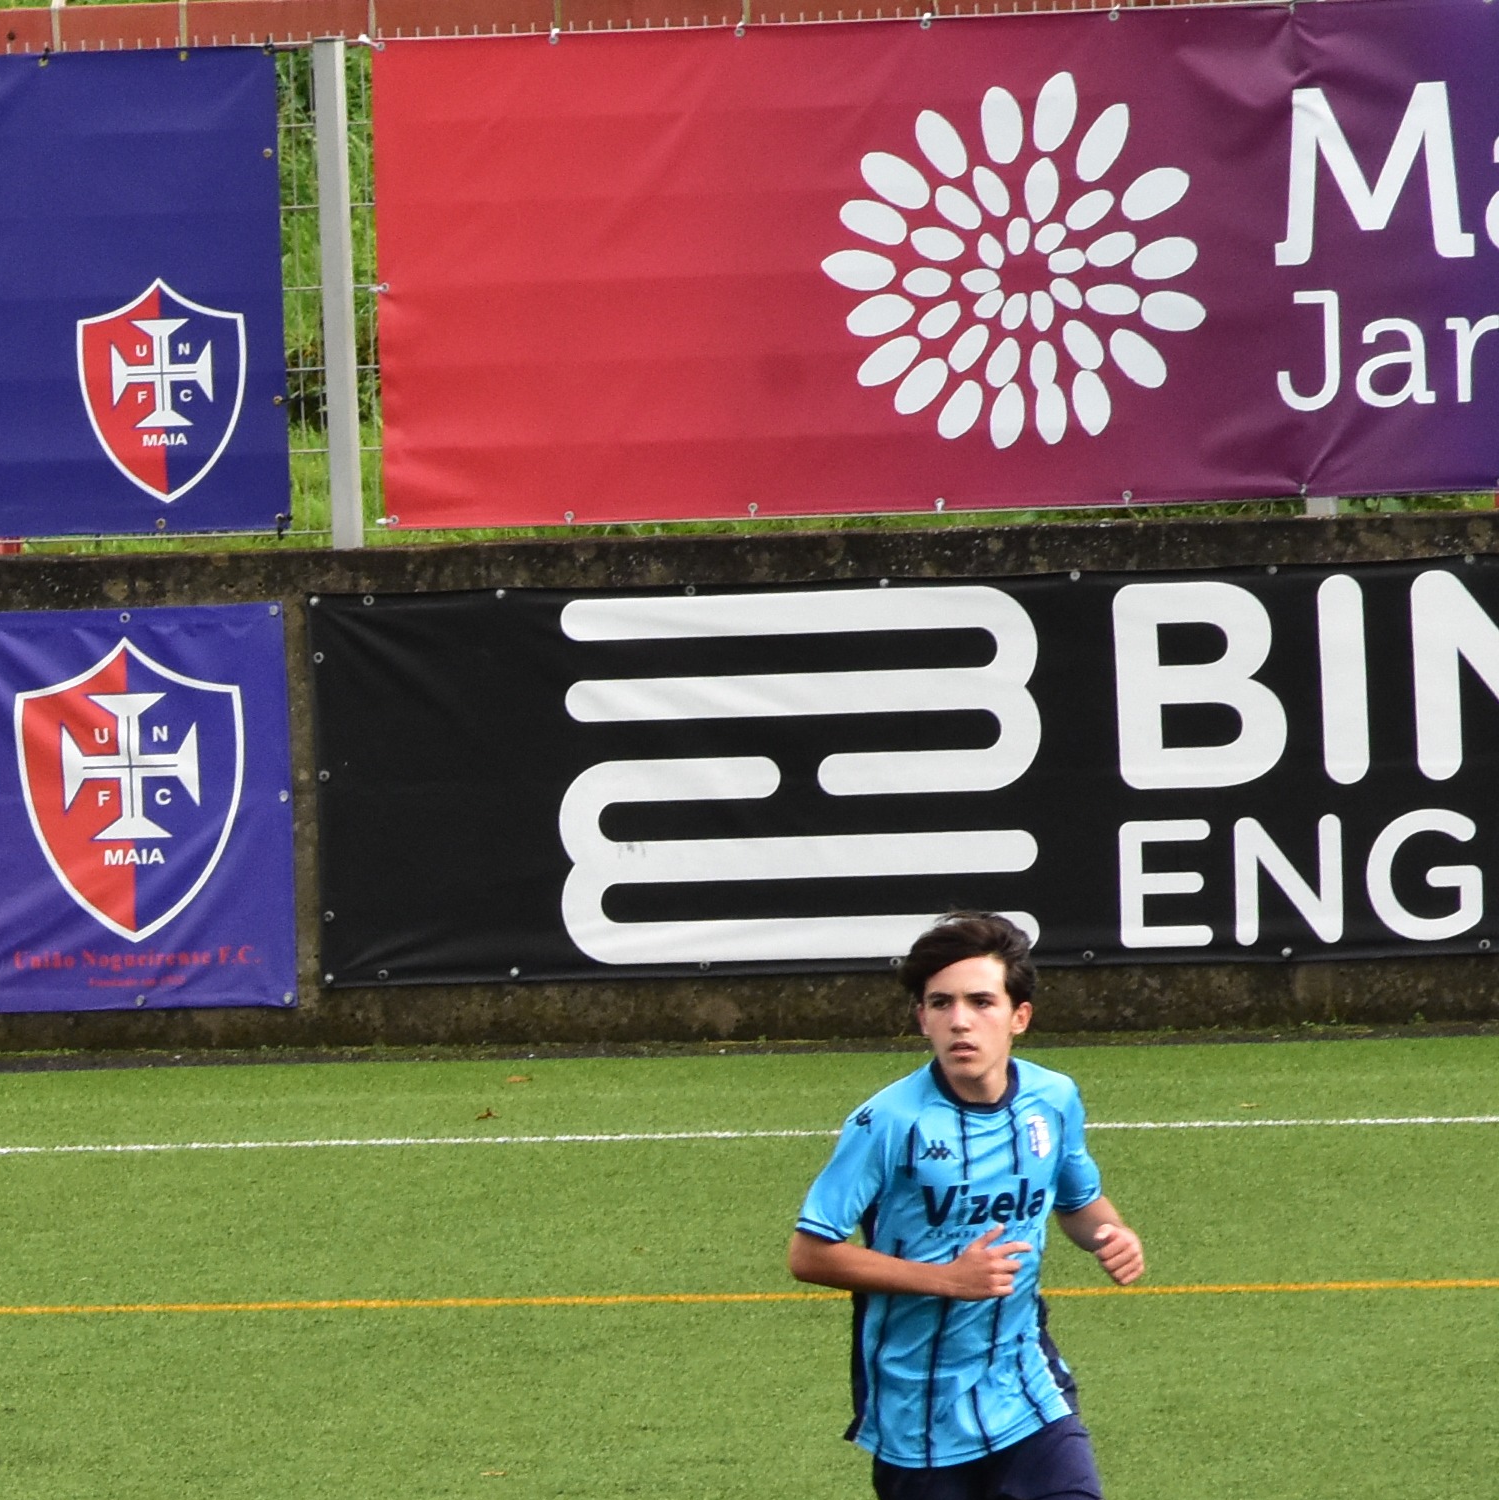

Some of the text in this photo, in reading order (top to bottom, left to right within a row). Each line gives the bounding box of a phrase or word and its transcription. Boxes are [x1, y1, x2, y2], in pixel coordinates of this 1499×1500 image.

[1275, 81, 1499, 266] M
[135, 342, 191, 358] U N
[1277, 290, 1499, 411] Jar
[137, 388, 193, 404] F C
[142, 433, 188, 446] MAIA
[94, 725, 169, 744] U N
[97, 788, 172, 807] F C
[104, 848, 166, 866] MAIA
[1118, 808, 1484, 948] ENG
[922, 1178, 1046, 1227] Vizela
